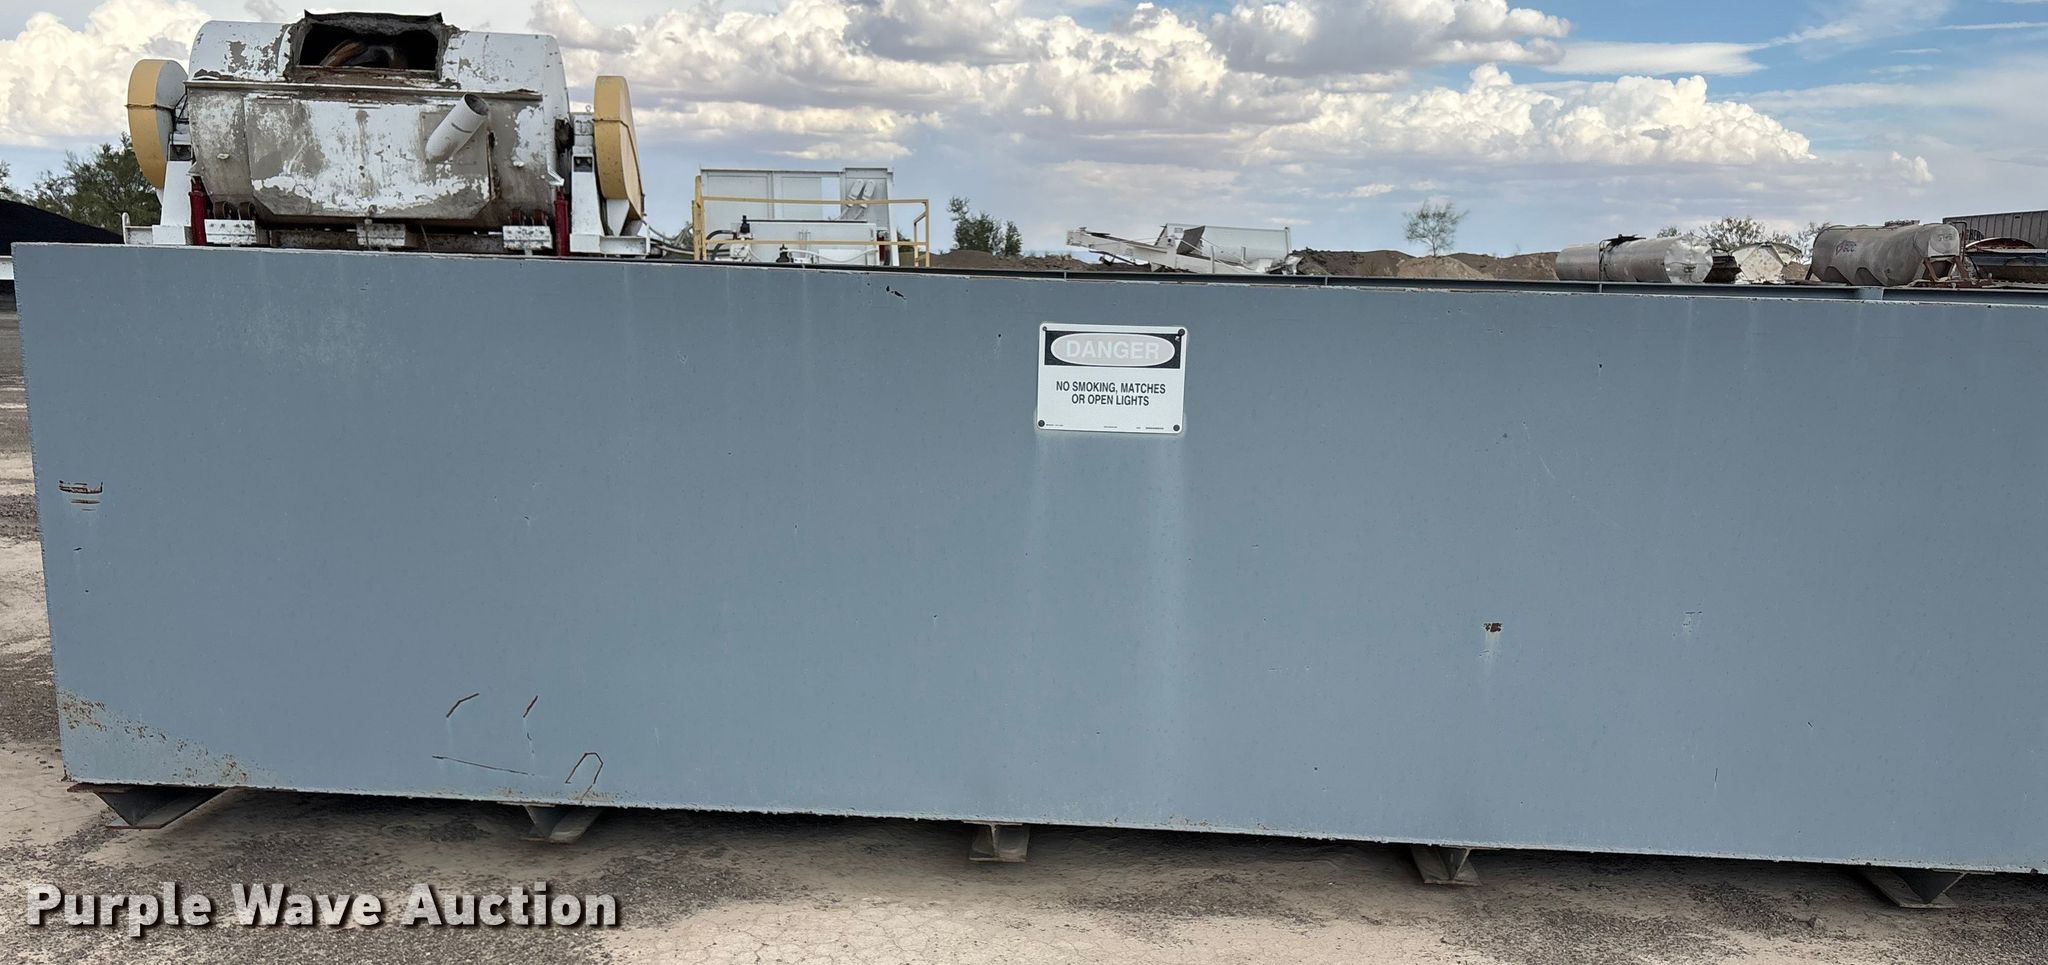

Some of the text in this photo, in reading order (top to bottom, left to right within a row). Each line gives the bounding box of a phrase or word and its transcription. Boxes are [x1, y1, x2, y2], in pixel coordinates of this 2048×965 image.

[1066, 340, 1160, 360] DANGER
[1056, 381, 1166, 394] NO SMOKING, MATCHES
[1071, 394, 1150, 406] OR OPEN LIGHTS
